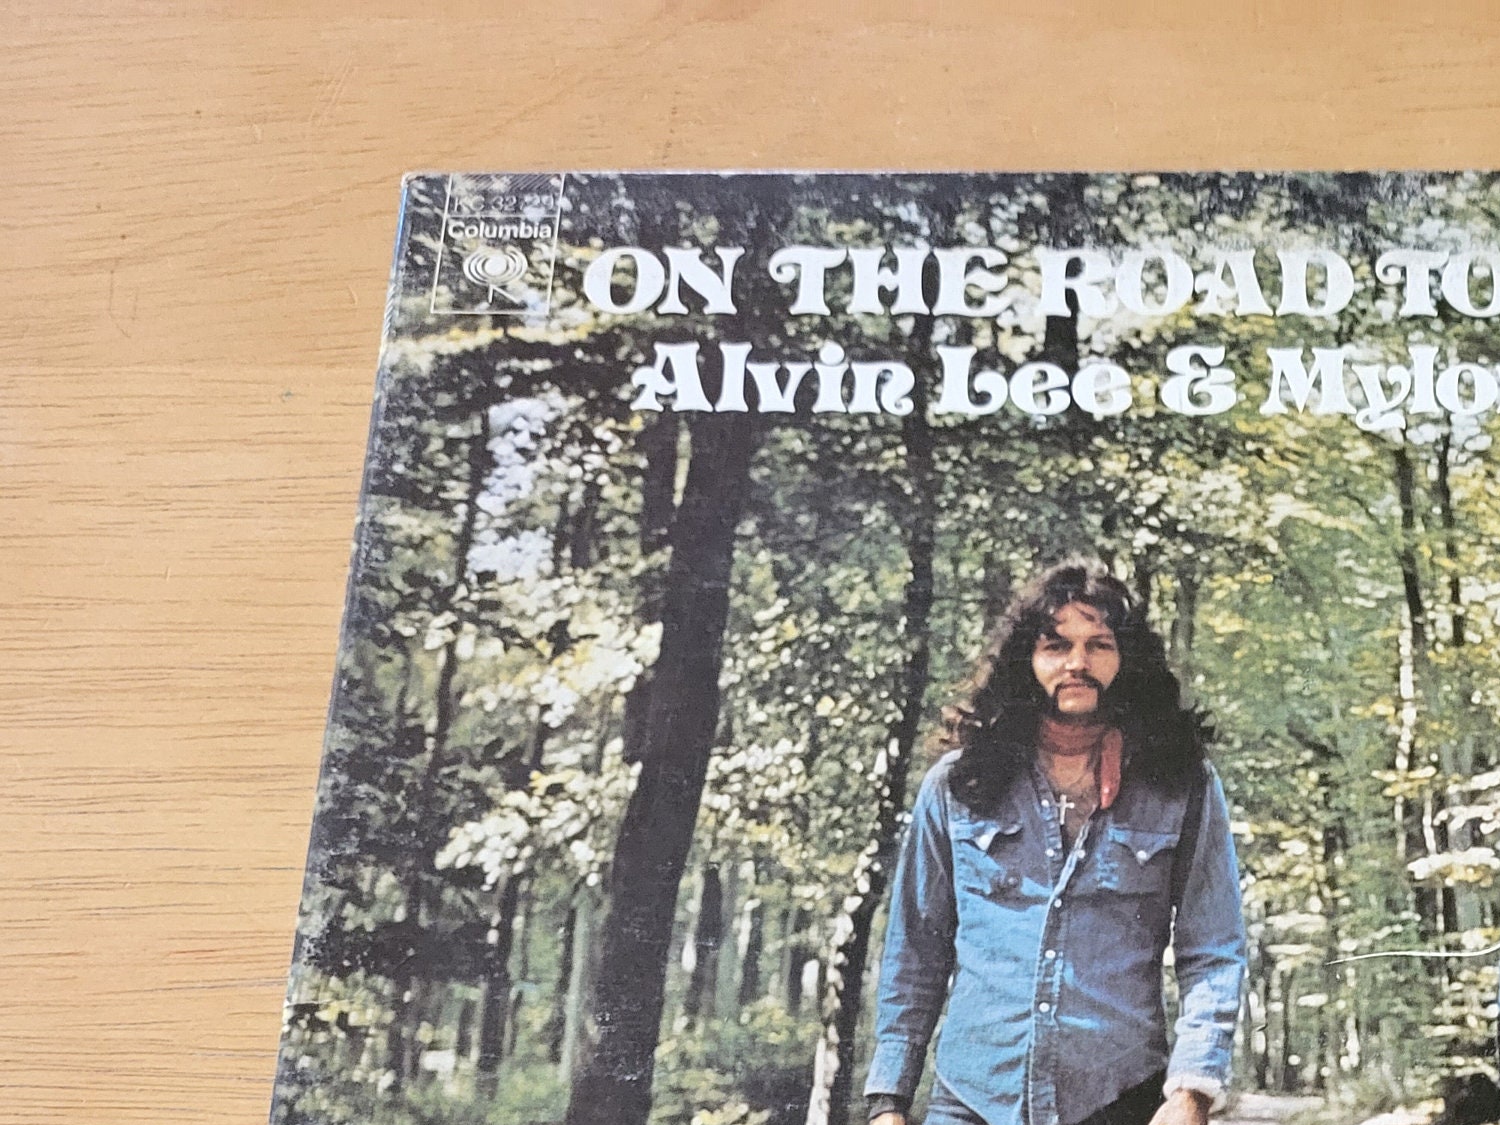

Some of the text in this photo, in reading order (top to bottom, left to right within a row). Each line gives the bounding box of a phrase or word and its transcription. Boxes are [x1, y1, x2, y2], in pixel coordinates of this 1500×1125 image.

[448, 221, 553, 239] Columbia
[583, 247, 747, 316] ON
[769, 247, 1008, 316] THE
[1036, 247, 1356, 318] ROAD
[630, 341, 915, 415] Alvin
[935, 344, 1133, 415] Lee
[1161, 345, 1238, 416] &
